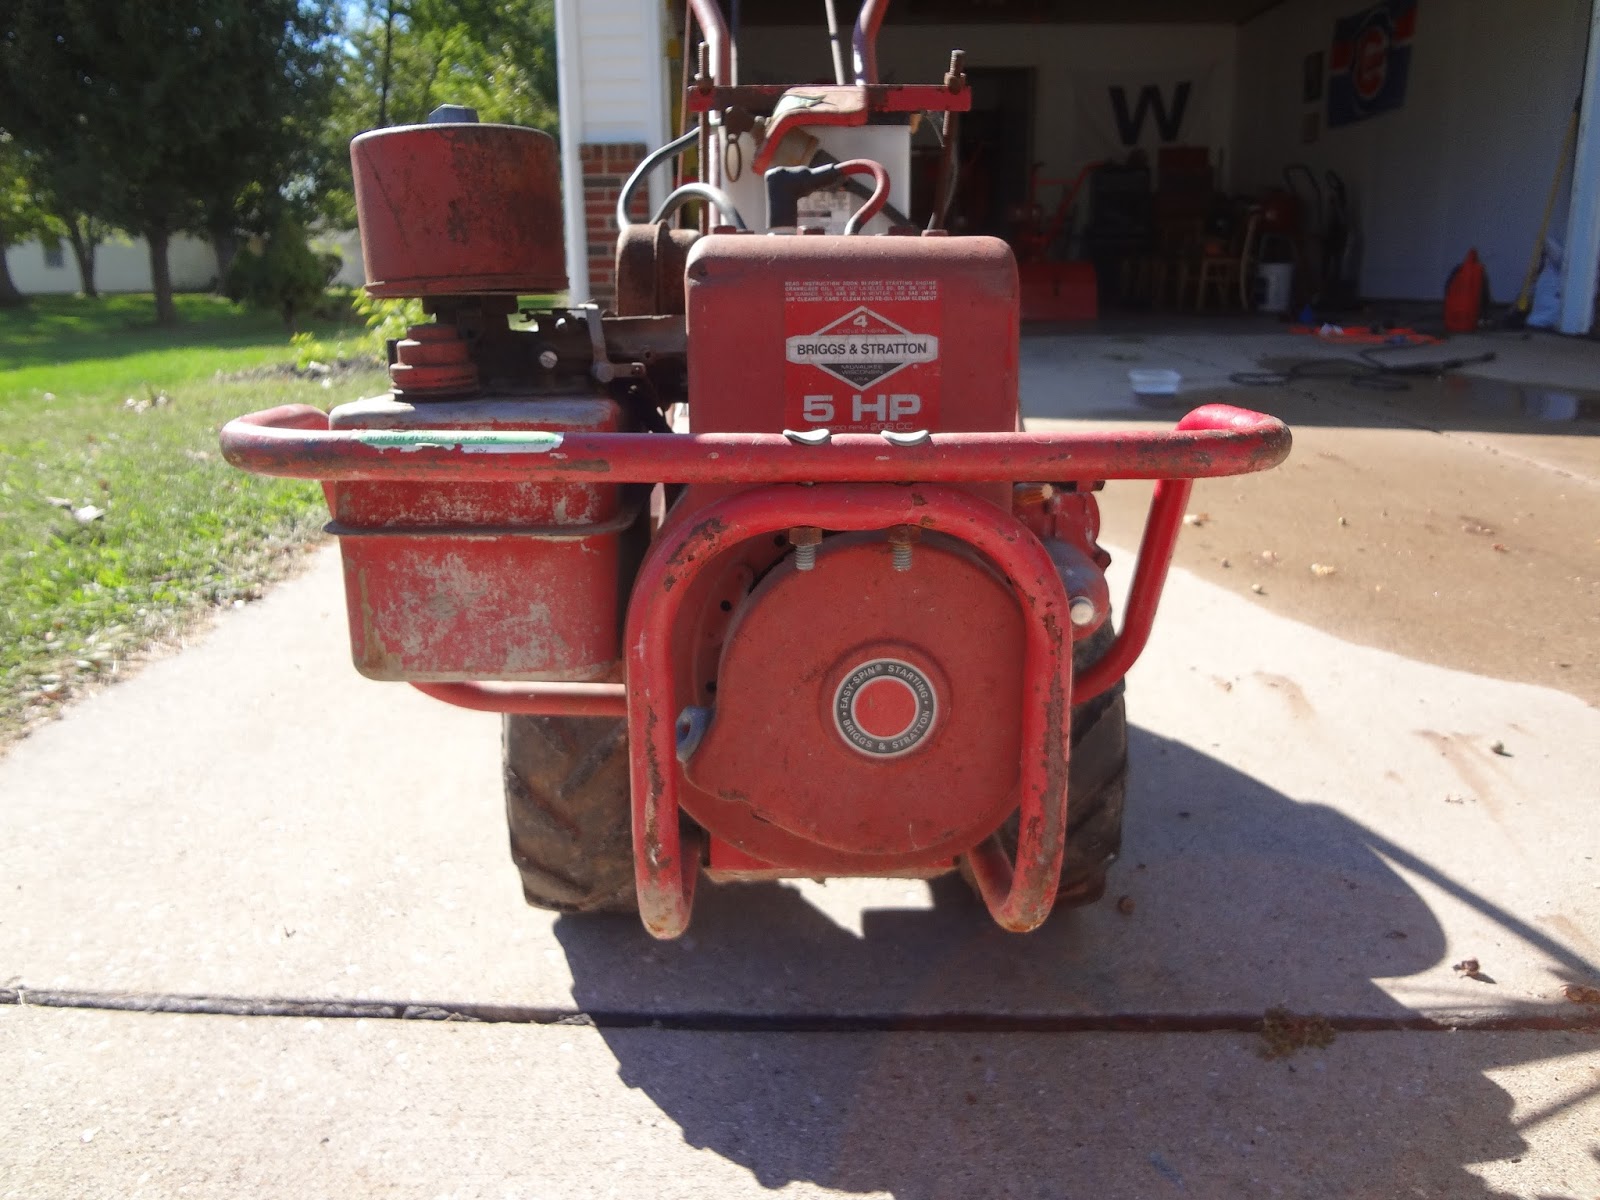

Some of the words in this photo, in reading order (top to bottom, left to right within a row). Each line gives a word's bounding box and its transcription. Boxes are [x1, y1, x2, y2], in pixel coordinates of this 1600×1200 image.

[1108, 80, 1192, 147] W
[852, 314, 868, 328] 4
[797, 344, 846, 355] BRIGGS
[850, 344, 858, 355] &
[860, 343, 927, 355] STRATTON
[803, 394, 835, 422] 5
[852, 394, 922, 422] HP
[888, 664, 928, 698] STARTING
[842, 719, 873, 748] BRIGGS
[878, 742, 886, 751] &
[892, 710, 930, 750] STRATTON
